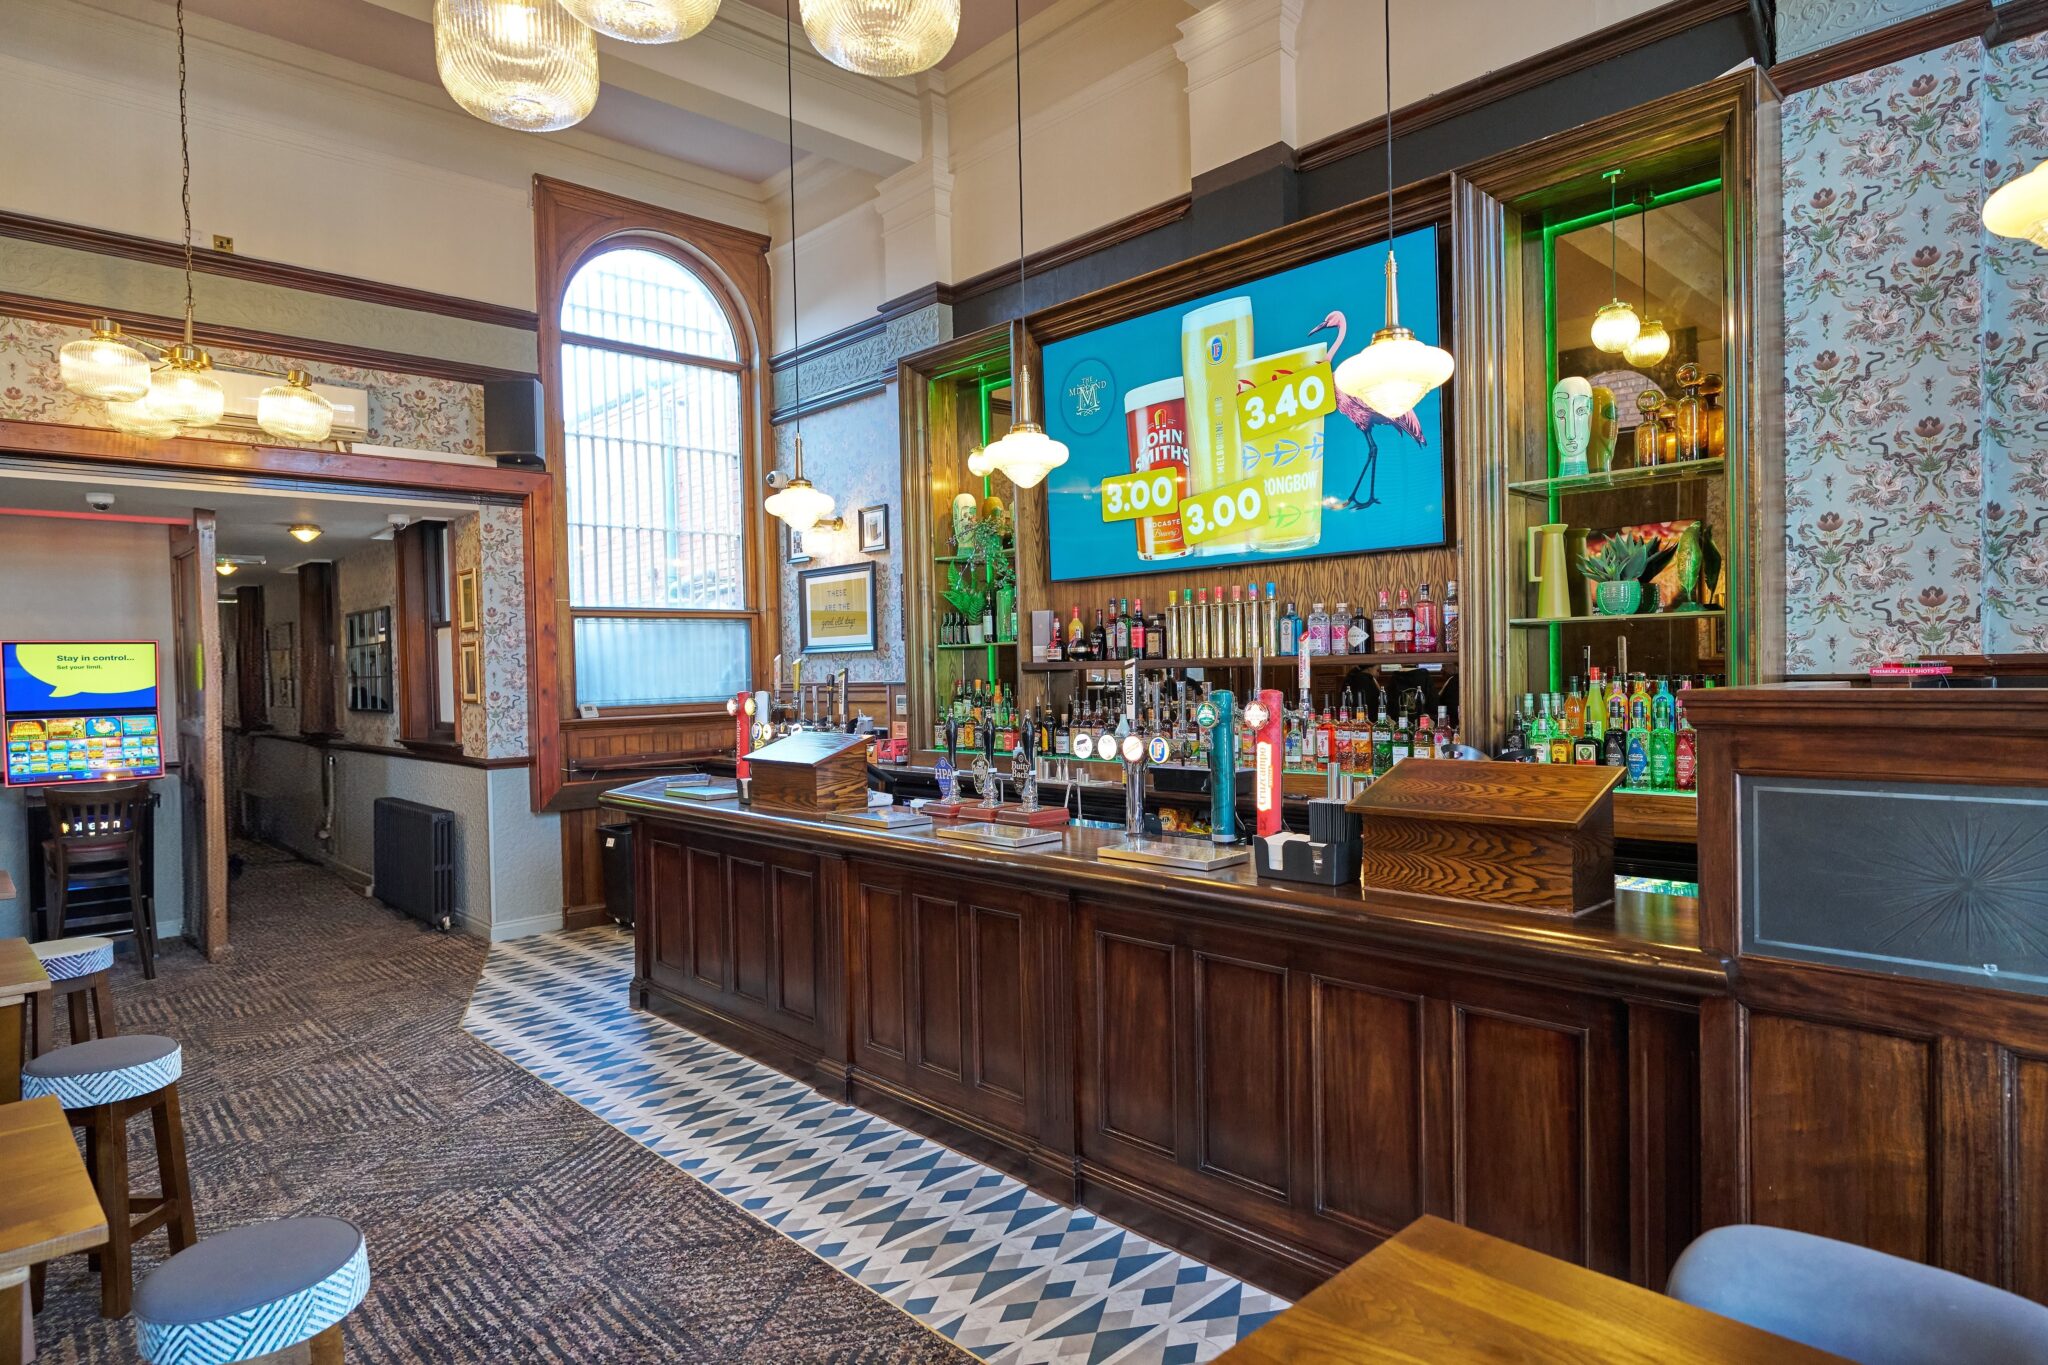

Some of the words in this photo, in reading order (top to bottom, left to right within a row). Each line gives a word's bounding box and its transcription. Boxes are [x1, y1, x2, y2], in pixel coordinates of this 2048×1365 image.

[1245, 375, 1325, 430] 3.40
[1142, 429, 1183, 451] JOHN
[1215, 421, 1224, 474] MELBOURNE
[1135, 444, 1190, 472] SMITH'S
[1107, 476, 1173, 513] 3.00
[1186, 488, 1261, 535] 3.00
[827, 589, 847, 597] THESE
[825, 603, 836, 611] ARE
[838, 602, 850, 610] THE
[56, 654, 79, 663] Stay
[1126, 673, 1134, 705] CARLING
[934, 768, 953, 780] HPA
[1011, 761, 1030, 772] Butty
[1011, 769, 1029, 779] Bach
[1258, 747, 1267, 805] Cruzcampo
